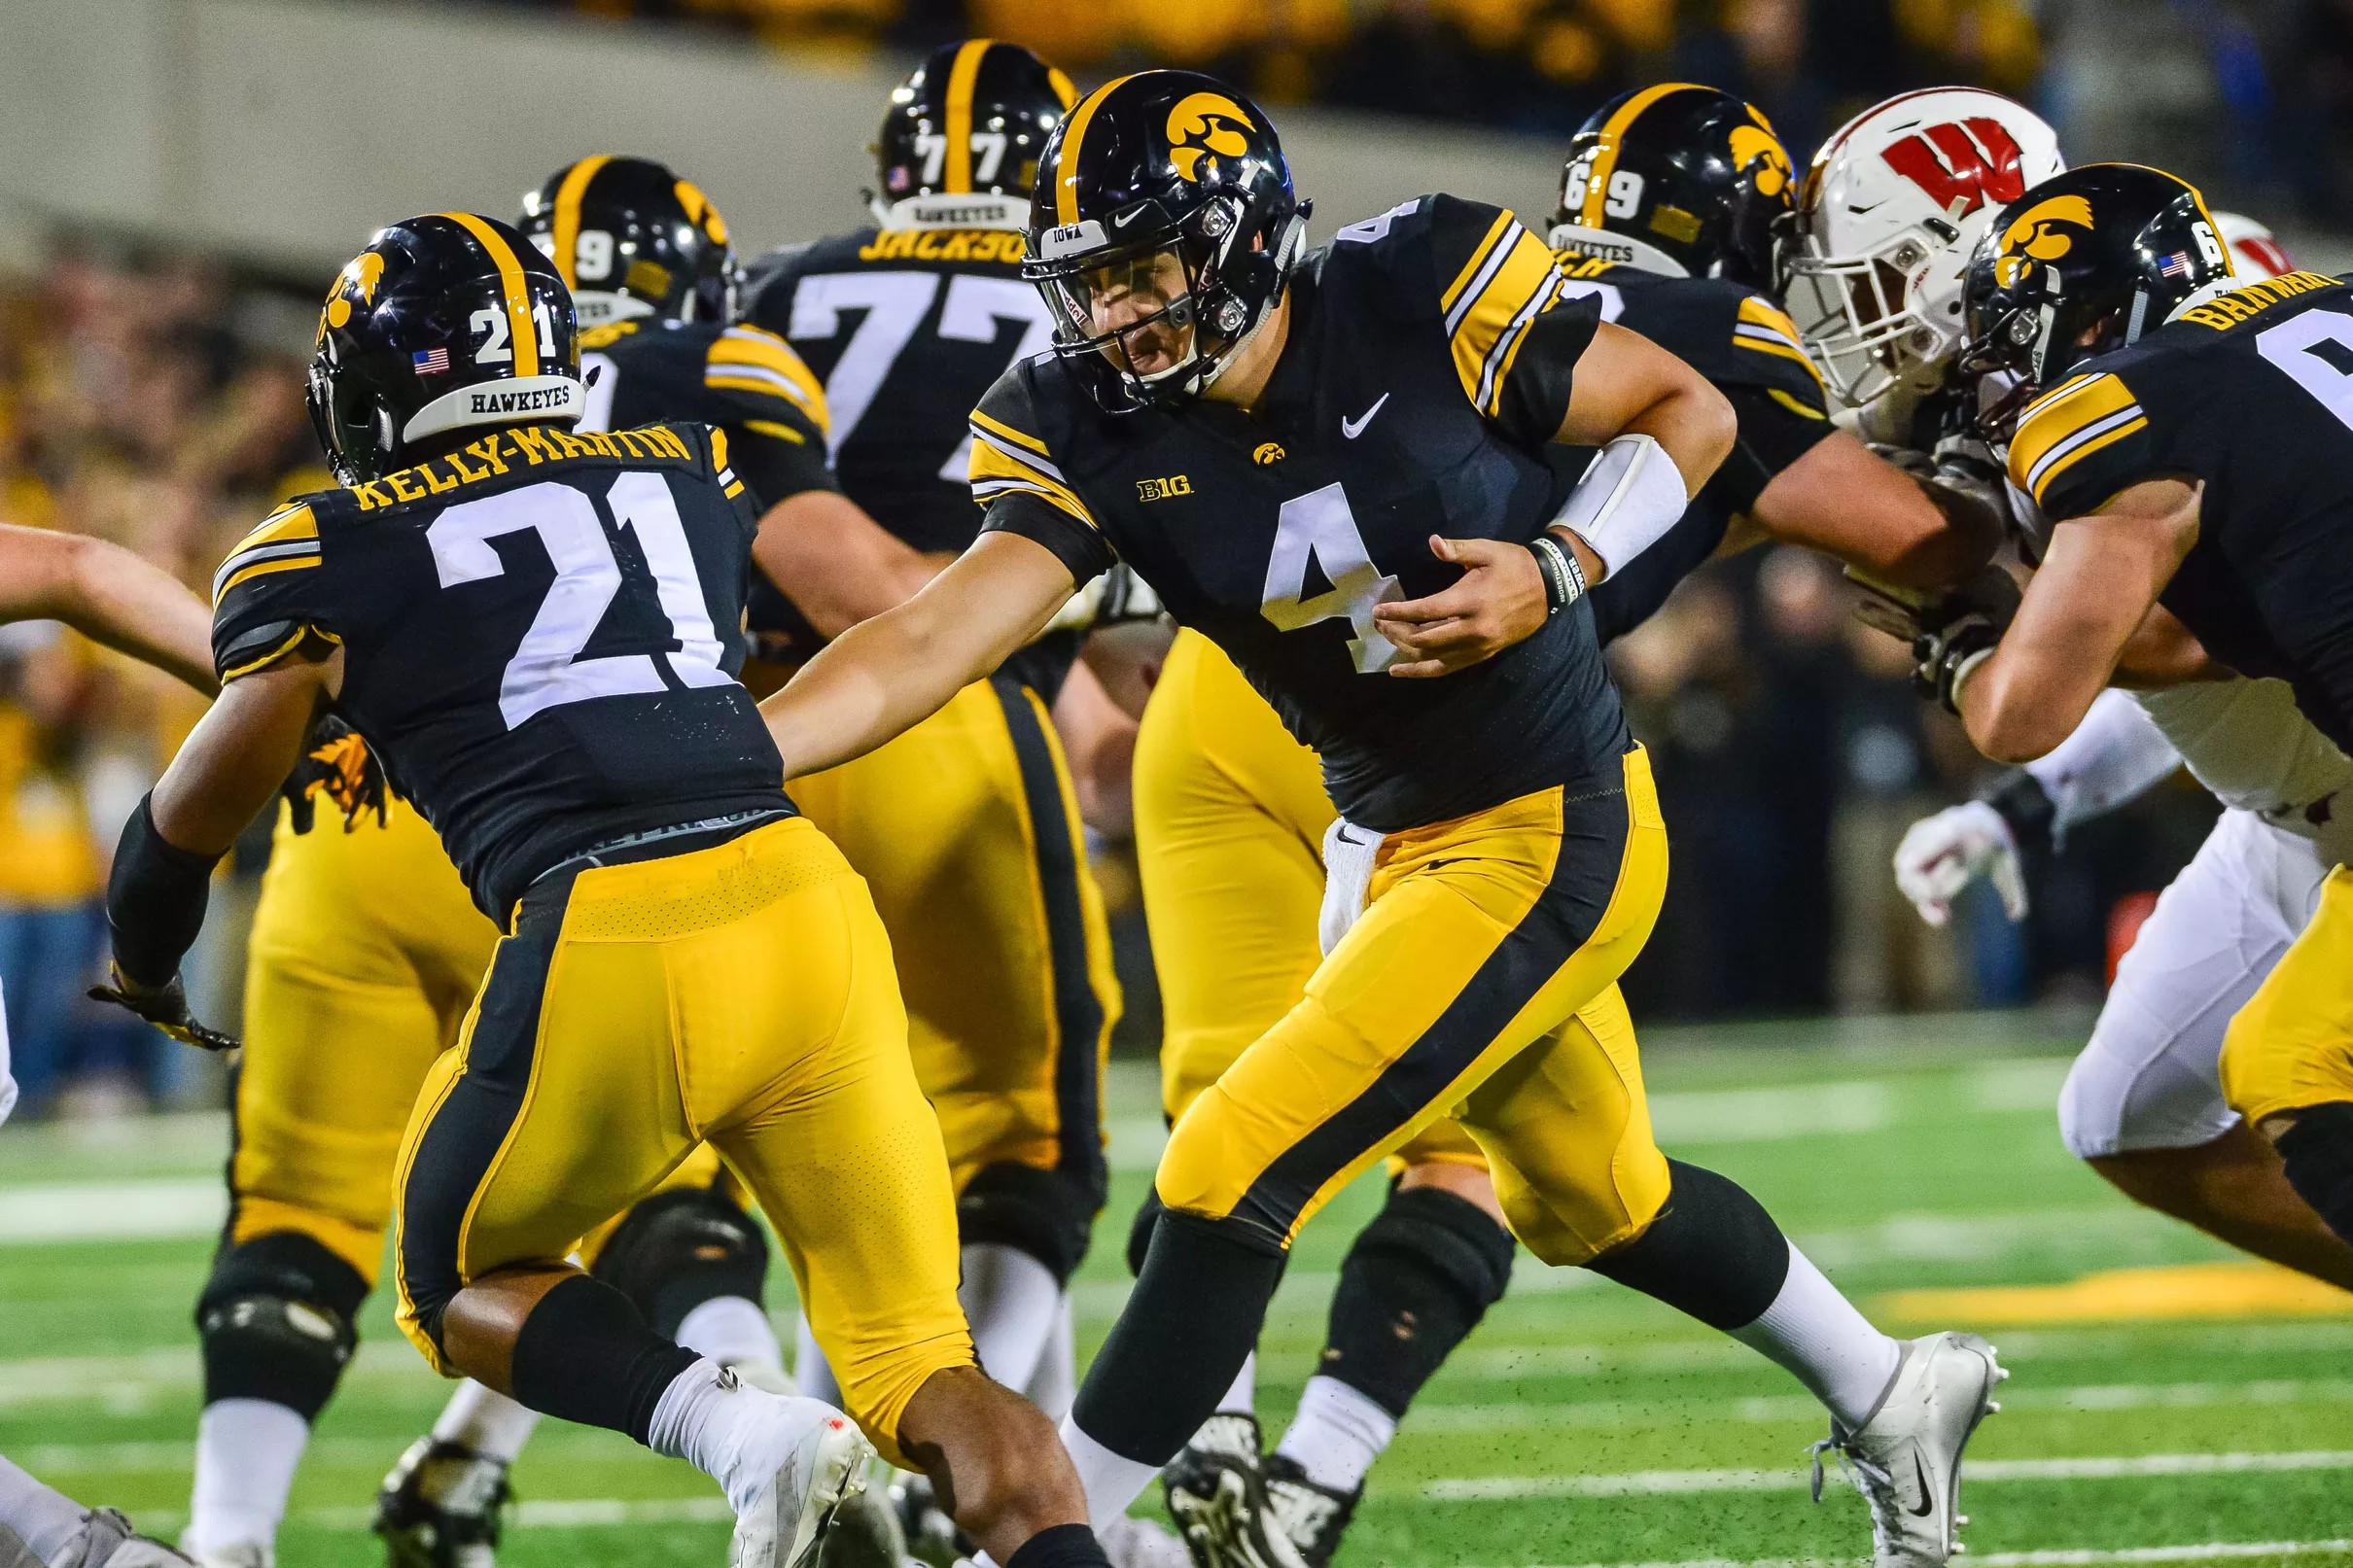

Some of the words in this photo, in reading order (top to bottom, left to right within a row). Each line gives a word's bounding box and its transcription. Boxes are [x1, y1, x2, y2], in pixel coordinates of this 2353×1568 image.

[914, 132, 1007, 184] 77
[1880, 117, 2025, 223] W
[1563, 162, 1645, 220] 69
[859, 229, 1027, 263] JACKSO
[1053, 226, 1083, 243] IOWA
[470, 300, 556, 365] 21
[471, 385, 569, 413] HAWKEYES
[788, 270, 1058, 486] 77
[350, 426, 691, 511] KELLY-MARTIN
[425, 471, 749, 731] 21
[1260, 481, 1414, 674] 4
